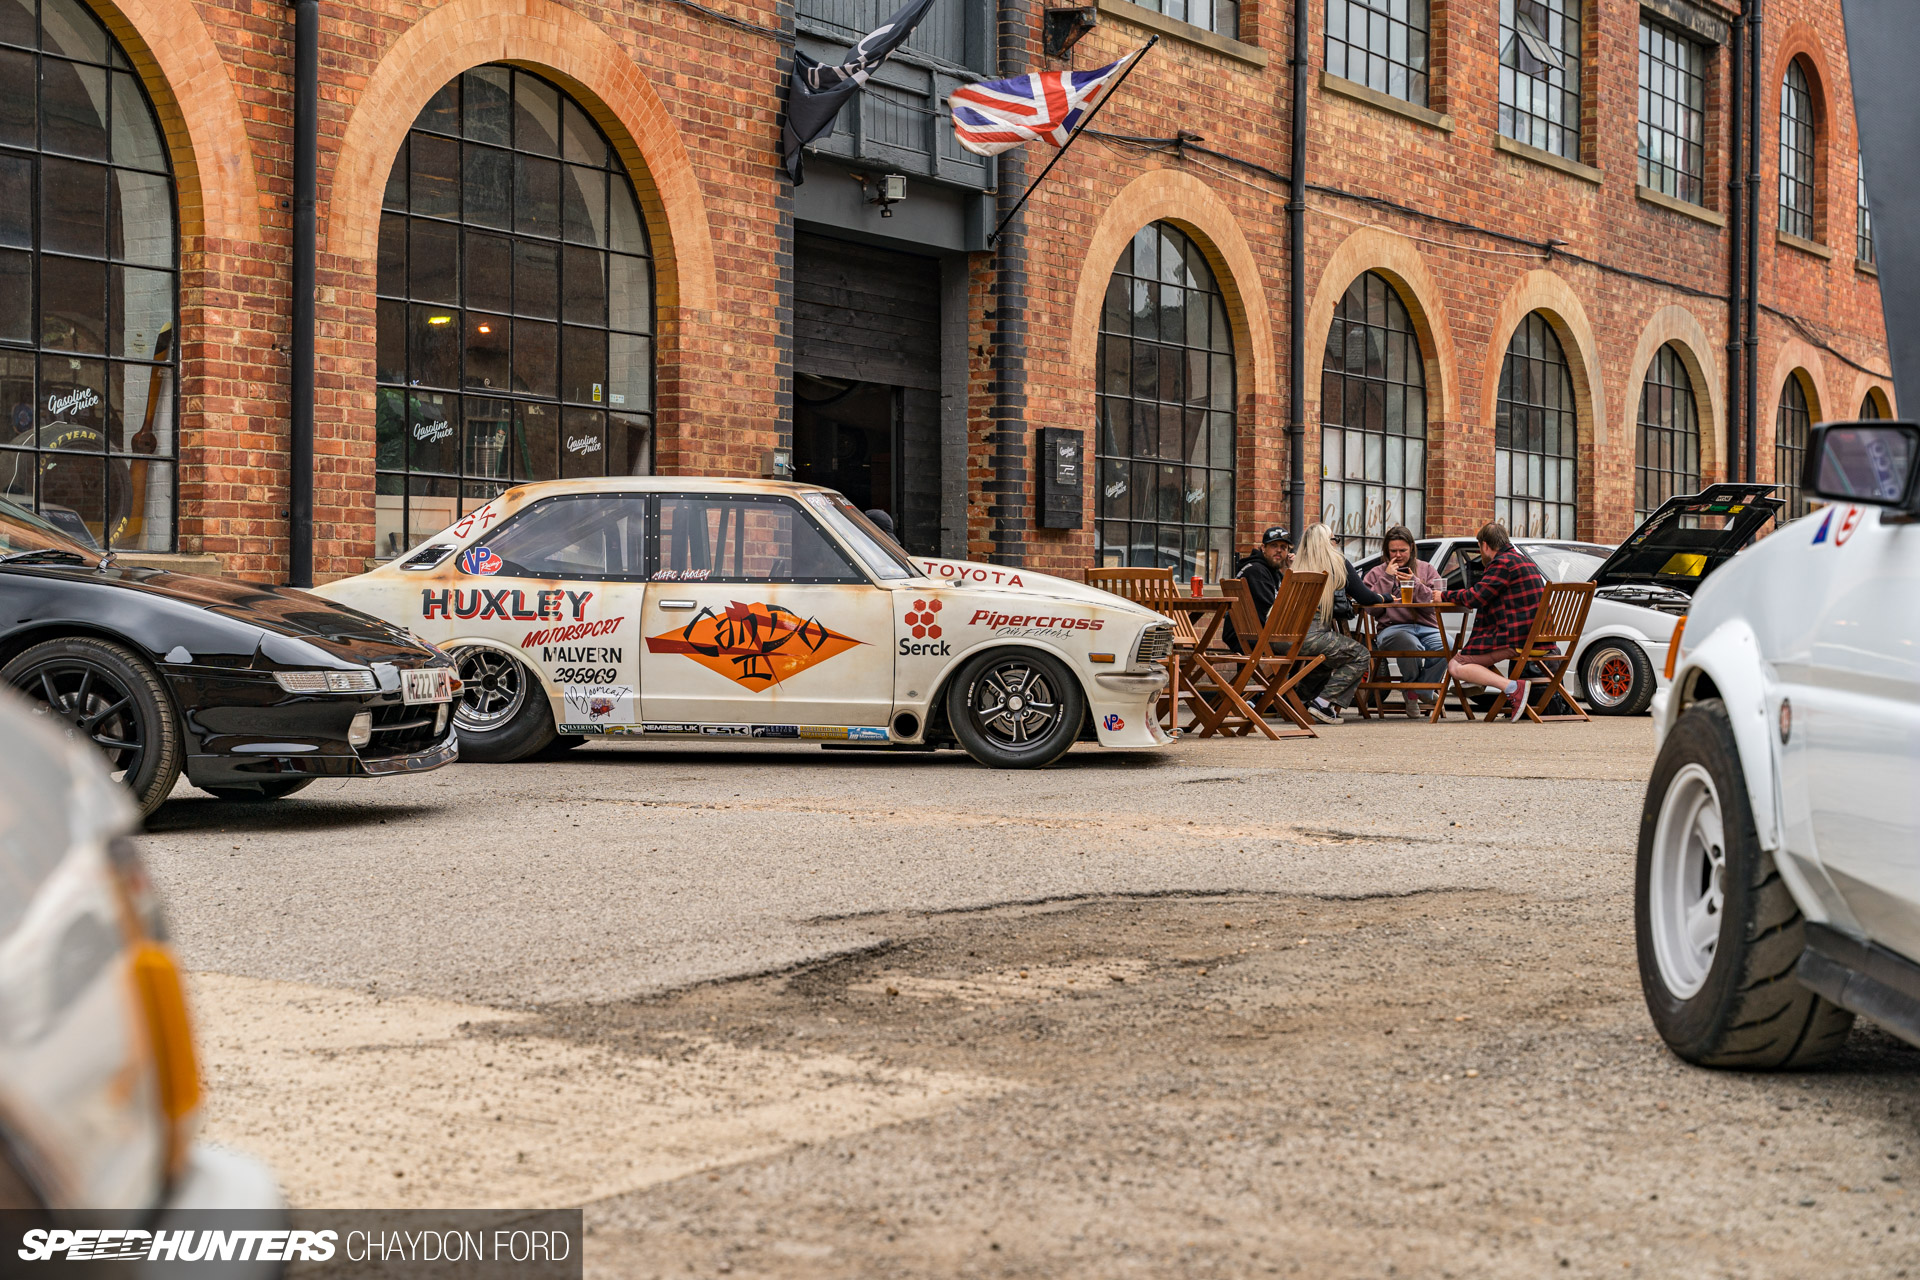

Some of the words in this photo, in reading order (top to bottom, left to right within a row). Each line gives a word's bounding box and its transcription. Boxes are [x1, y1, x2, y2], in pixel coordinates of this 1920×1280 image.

[48, 388, 91, 414] Gasoline
[70, 395, 99, 415] Juice
[413, 420, 448, 440] Gasoline
[430, 427, 453, 443] Juice
[567, 435, 598, 452] Gasoline
[581, 442, 601, 455] Juice
[464, 547, 491, 575] VP
[680, 569, 711, 580] HUXLEY
[923, 561, 1024, 588] TOYOTA
[421, 588, 594, 622] HUXLEY
[968, 609, 1105, 631] Pipercross
[521, 616, 625, 648] MOTORSPORT
[543, 647, 622, 663] MALVERN
[898, 637, 951, 656] Serck
[553, 667, 618, 684] 295969
[560, 724, 602, 733] SILVERTON
[1104, 713, 1119, 731] VP
